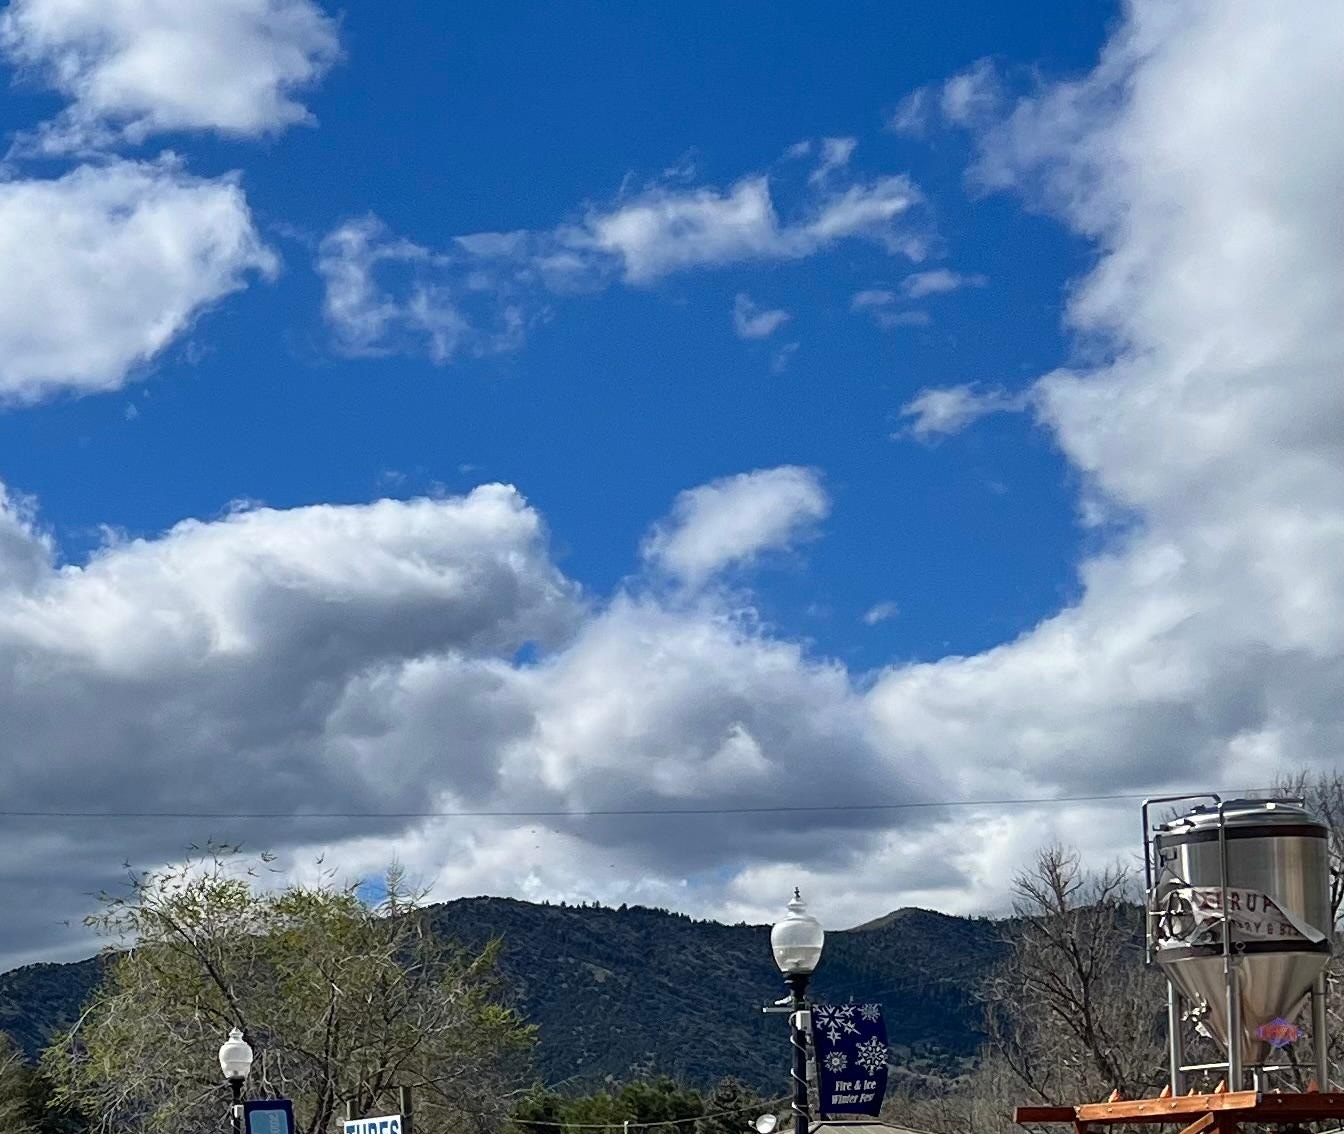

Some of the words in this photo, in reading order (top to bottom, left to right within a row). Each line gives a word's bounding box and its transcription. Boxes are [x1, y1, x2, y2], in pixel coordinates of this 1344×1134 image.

[835, 1081, 852, 1091] Fire
[854, 1080, 861, 1090] &
[863, 1079, 876, 1090] Ice
[831, 1093, 857, 1105] Winter
